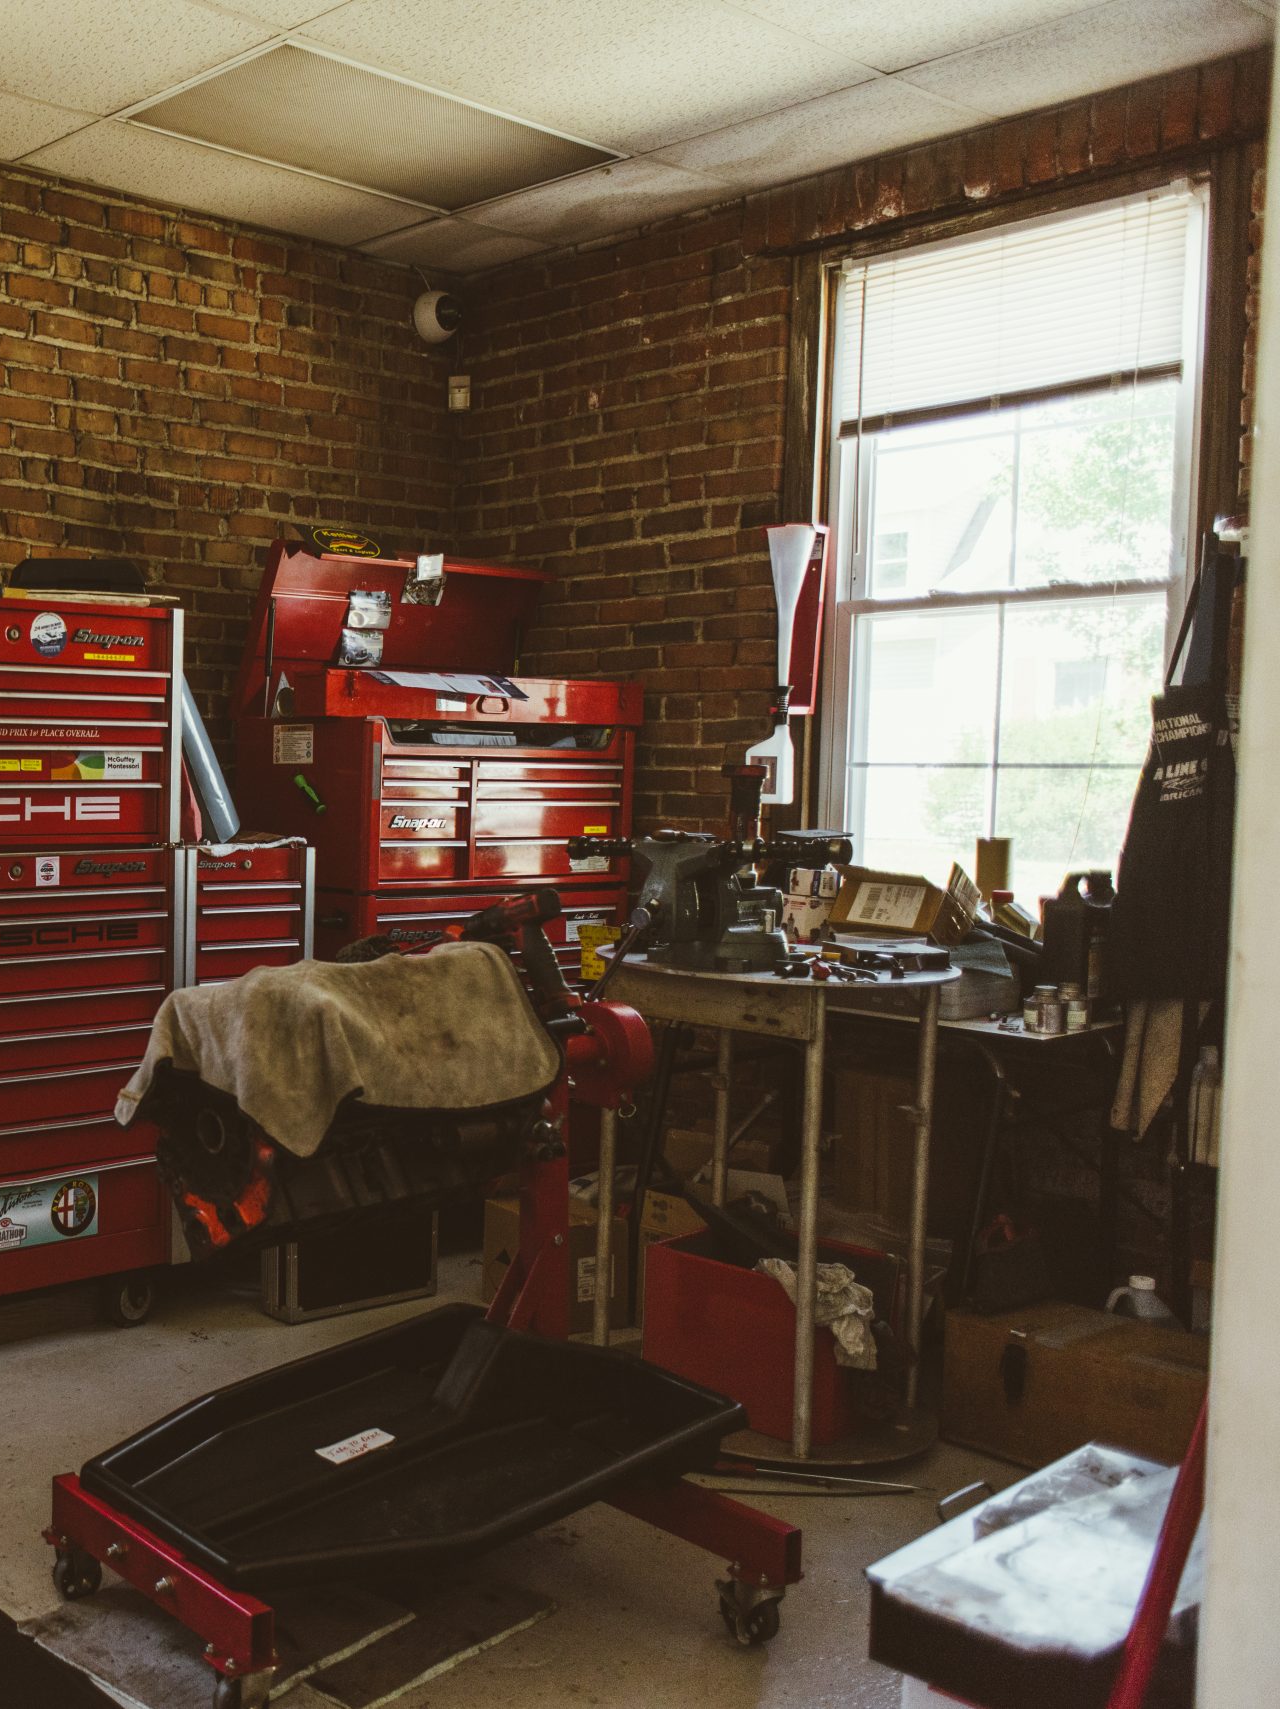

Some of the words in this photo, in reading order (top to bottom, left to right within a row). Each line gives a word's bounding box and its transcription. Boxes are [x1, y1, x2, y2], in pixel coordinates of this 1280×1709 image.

[1154, 713, 1202, 732] NATIONAL
[9, 729, 28, 737] PRIX
[40, 729, 65, 737] PLACE
[66, 729, 99, 738] OVERALL
[107, 756, 136, 764] McGuffey
[1165, 760, 1198, 779] LINE
[388, 814, 447, 832] Snap-on
[197, 861, 237, 870] Snap-on
[52, 1185, 69, 1212] ALFA
